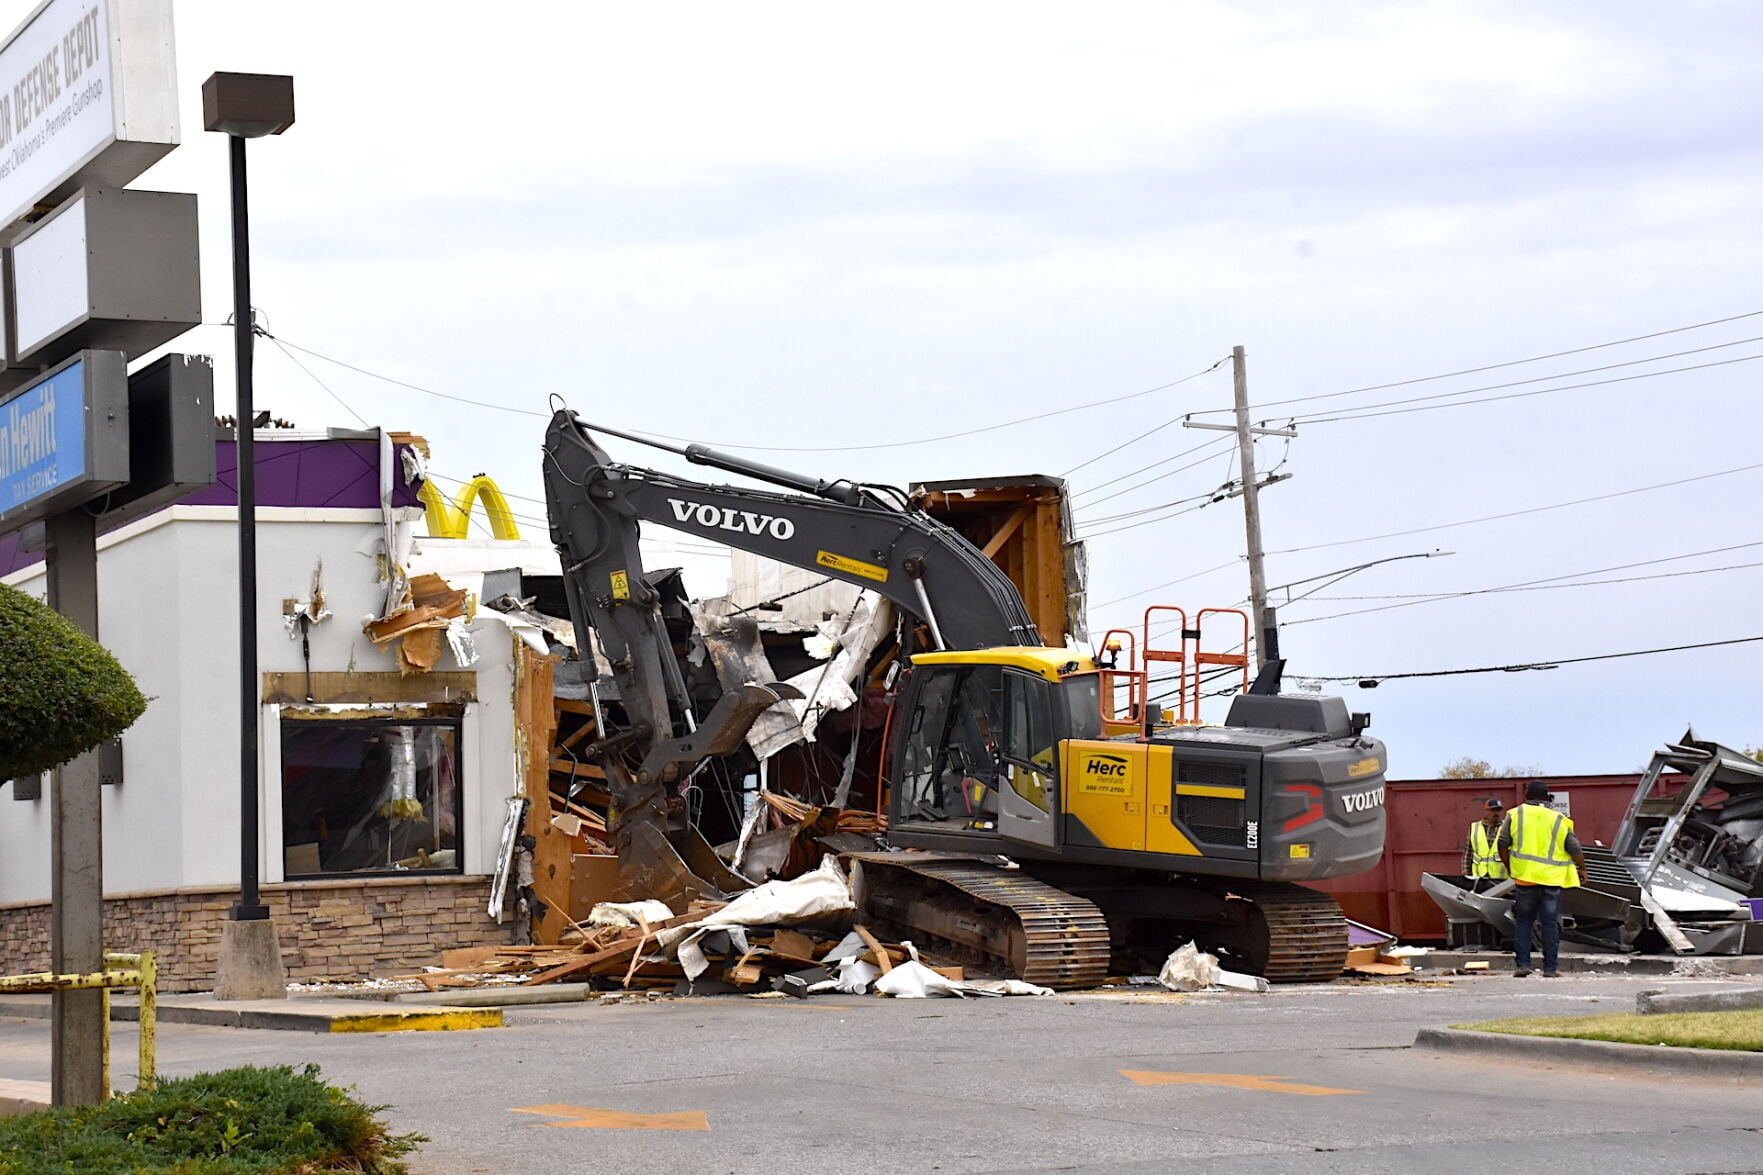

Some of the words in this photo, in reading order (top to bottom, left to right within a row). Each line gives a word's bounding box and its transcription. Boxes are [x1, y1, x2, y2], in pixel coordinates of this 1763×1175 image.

[14, 44, 61, 135] DEFENSE
[63, 5, 99, 88] DEPOT
[11, 128, 45, 170] Oklahoma's
[72, 78, 102, 116] Gunshop
[10, 383, 57, 474] Hewitt
[27, 463, 58, 496] SERVICE
[667, 498, 795, 540] VOLVO
[1086, 759, 1127, 777] Herc
[1096, 775, 1124, 785] Rentals
[1341, 786, 1385, 813] VOLVO
